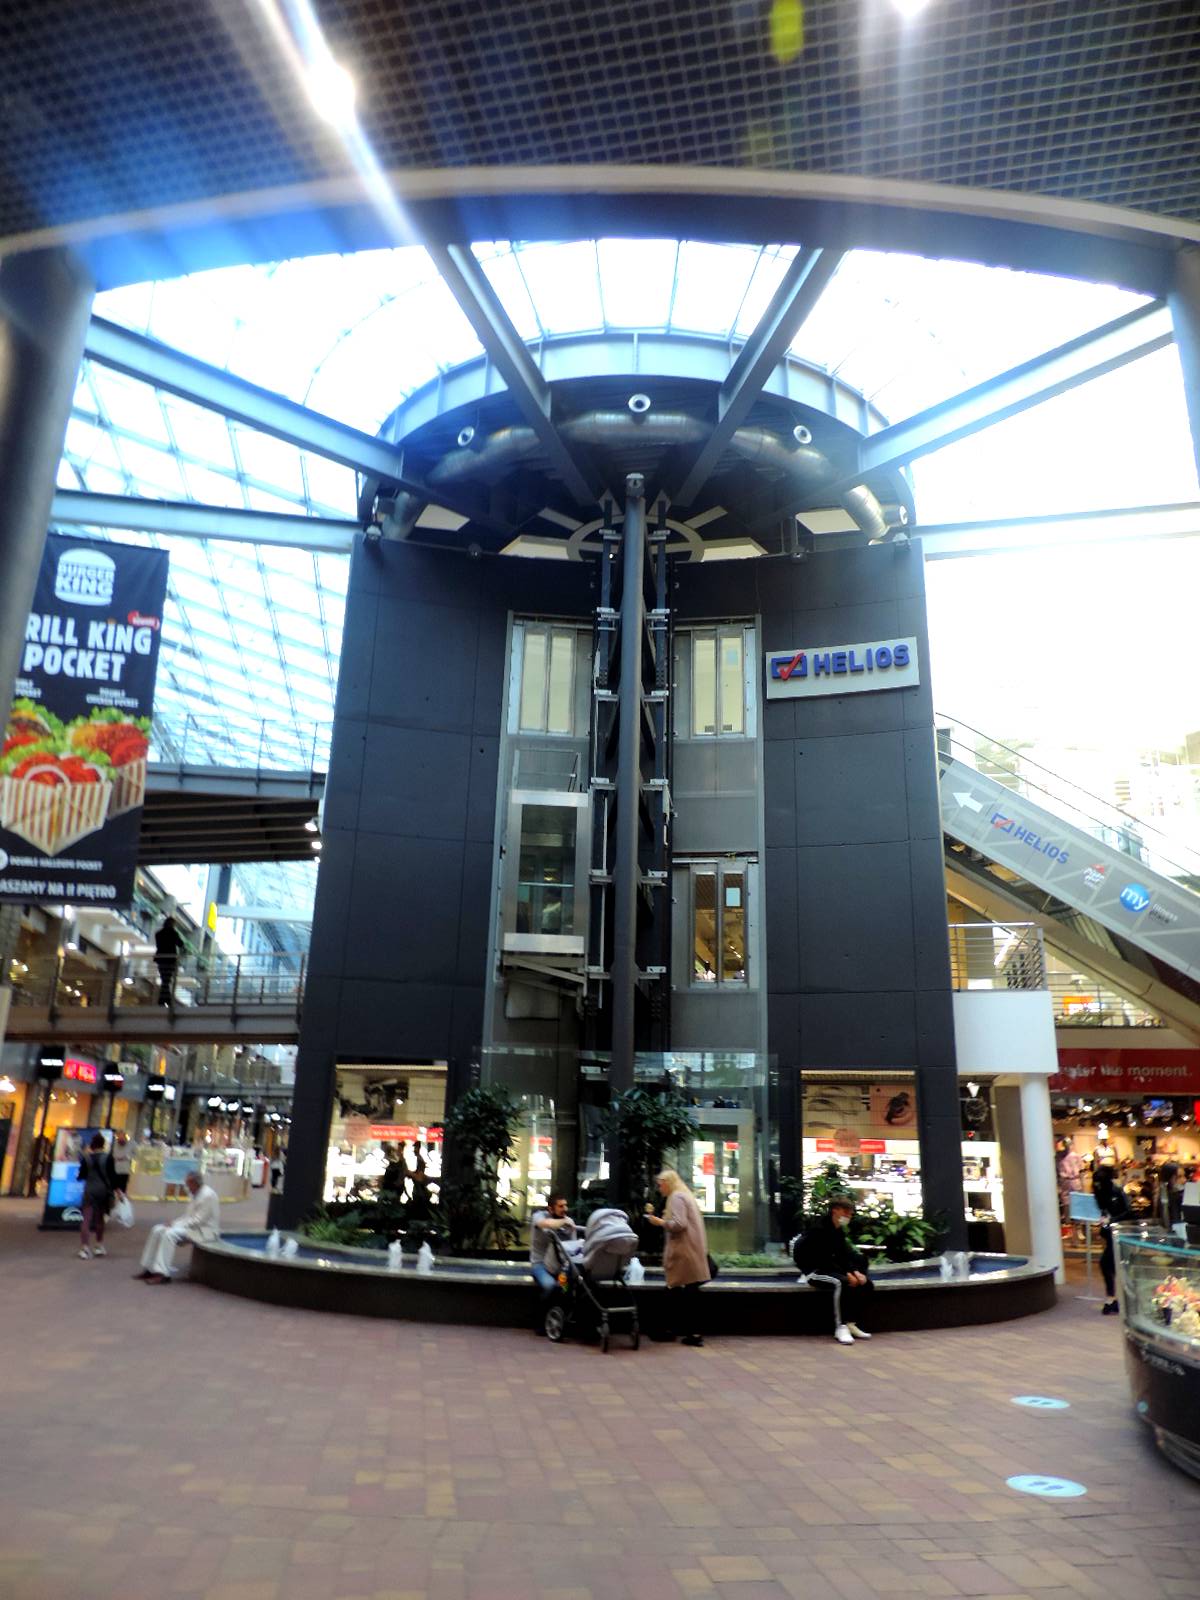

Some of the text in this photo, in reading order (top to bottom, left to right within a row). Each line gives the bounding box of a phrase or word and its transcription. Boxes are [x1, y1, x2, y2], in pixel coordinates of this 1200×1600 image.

[56, 575, 114, 596] KING
[58, 562, 116, 582] BURGER
[88, 620, 152, 655] KING
[22, 642, 126, 682] POCKET
[813, 644, 911, 676] HELIOS
[1013, 825, 1070, 865] HELIOS
[48, 881, 65, 896] NA
[77, 883, 117, 901] PIĘTRO
[1120, 887, 1150, 911] my
